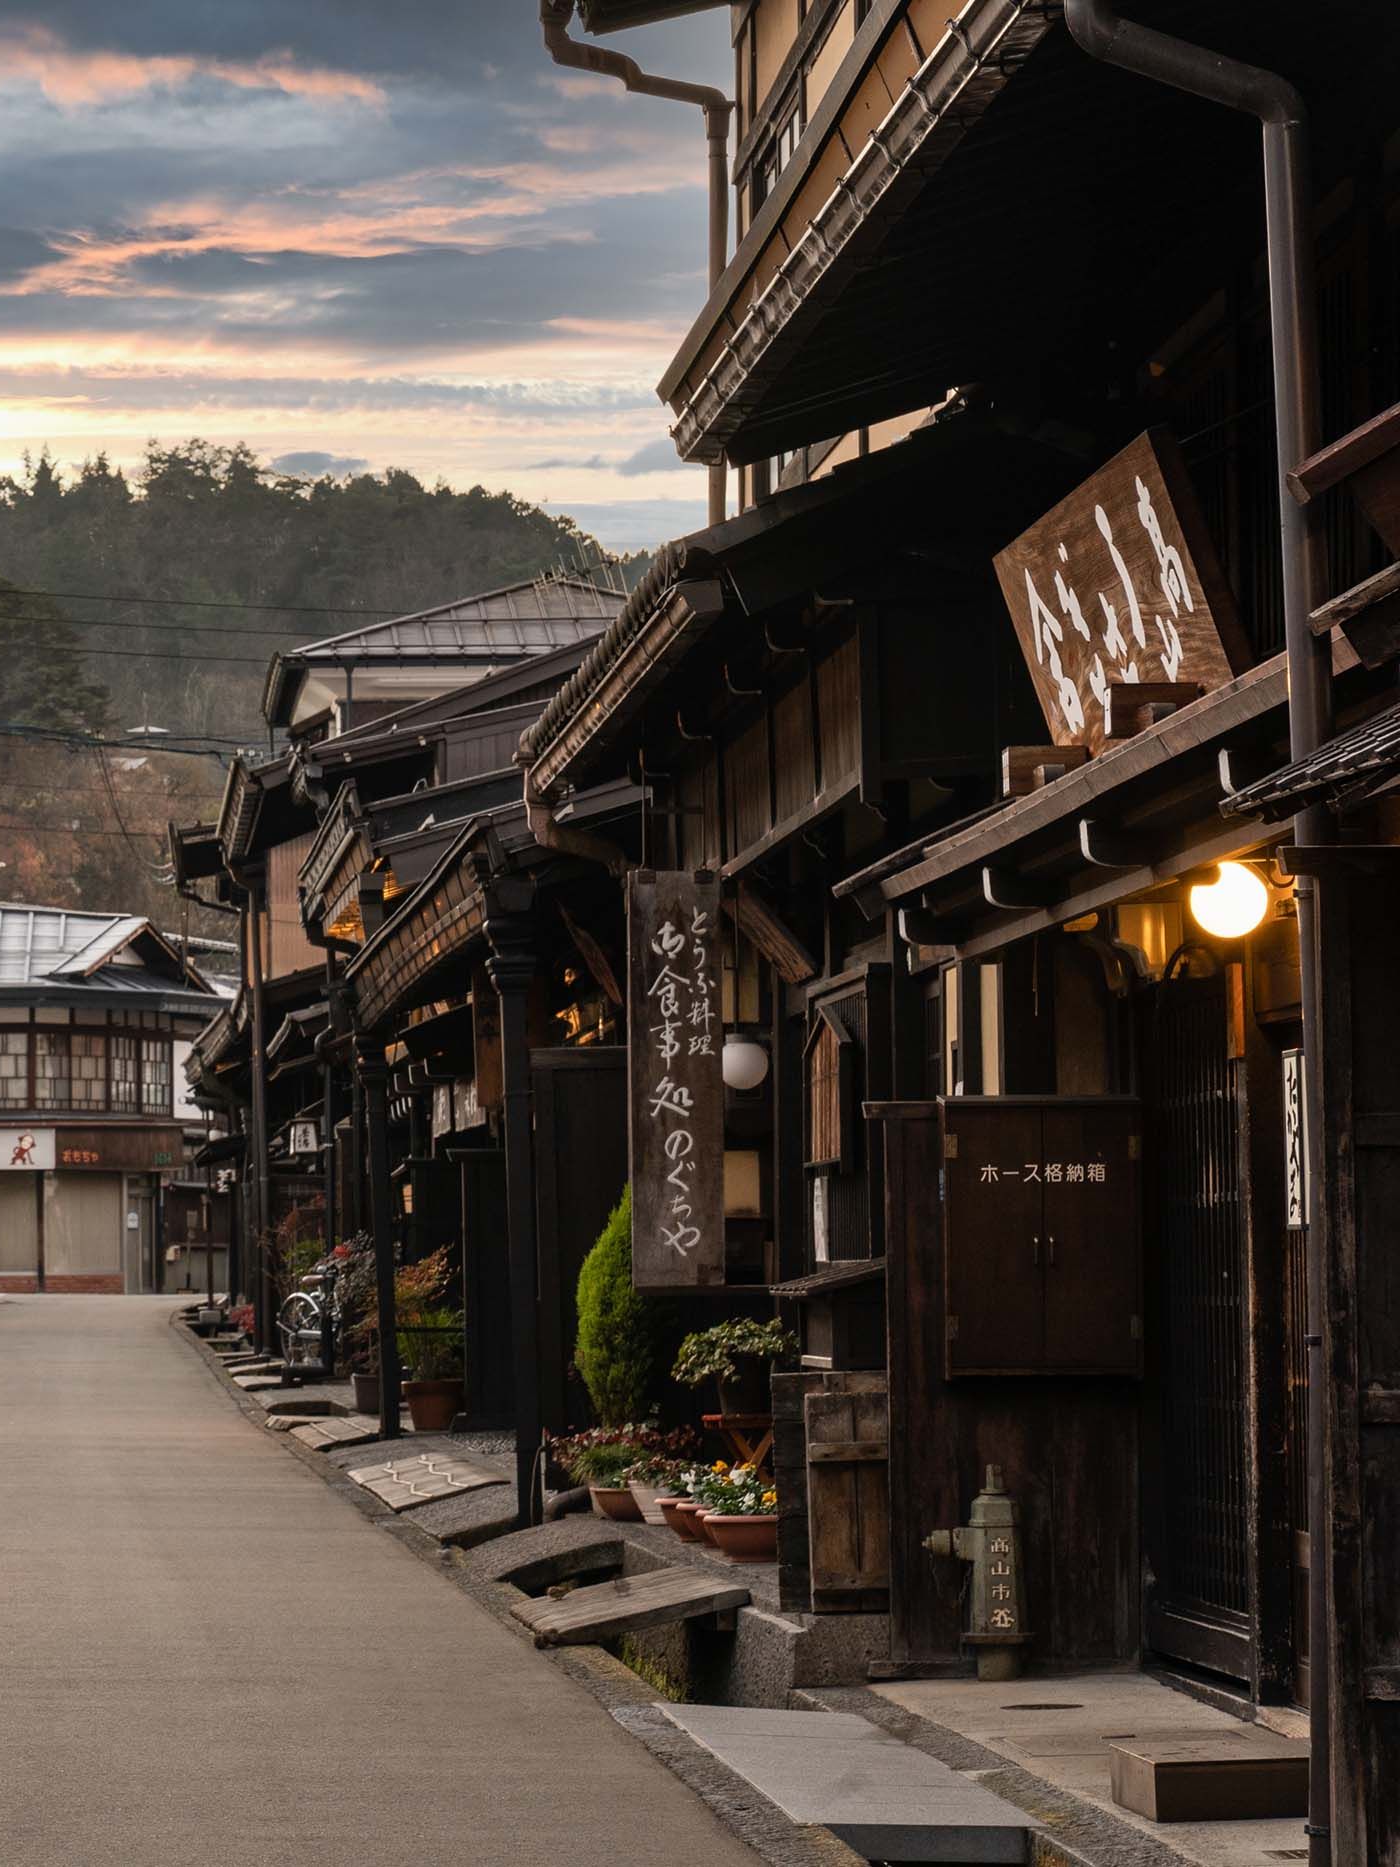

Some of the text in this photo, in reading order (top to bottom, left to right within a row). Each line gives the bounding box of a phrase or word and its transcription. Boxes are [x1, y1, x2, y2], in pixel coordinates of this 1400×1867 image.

[688, 906, 716, 1057] とうふ料理
[62, 1149, 99, 1163] おもちゃ
[980, 1164, 1106, 1184] ホース格納箱
[991, 1537, 1011, 1601] 高山市
